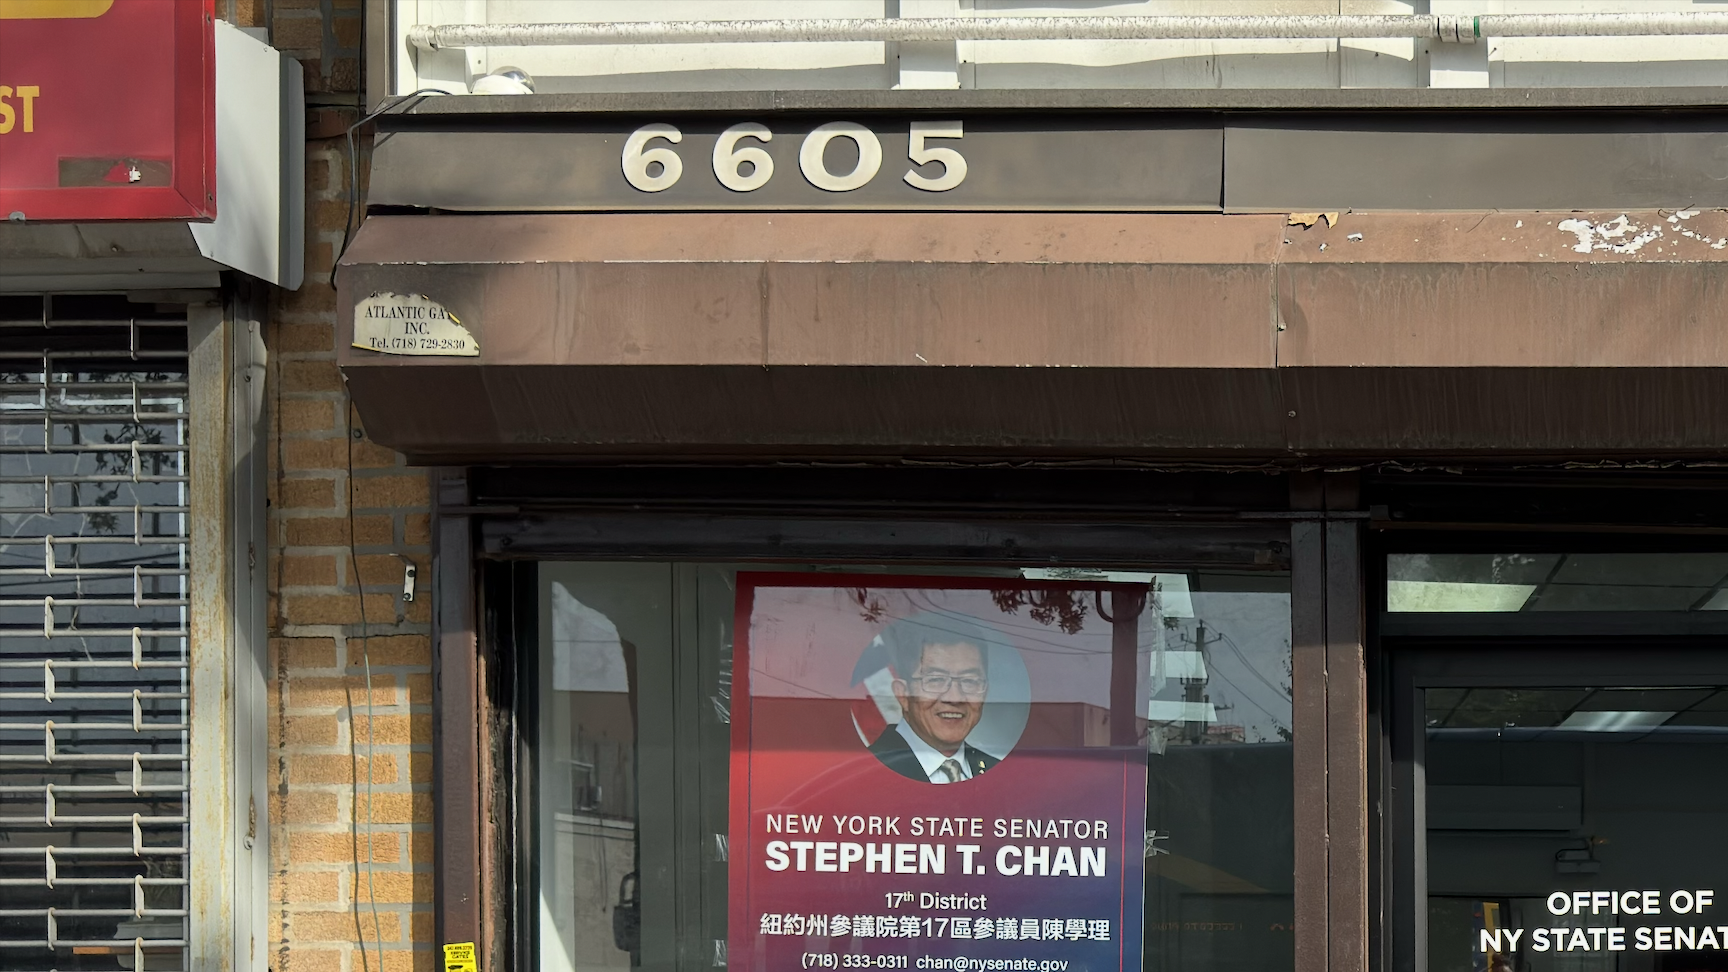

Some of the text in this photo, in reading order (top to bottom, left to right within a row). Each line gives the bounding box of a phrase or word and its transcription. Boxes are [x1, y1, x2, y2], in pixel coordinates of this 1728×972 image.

[621, 121, 968, 193] 6605
[365, 305, 425, 320] ATLANTIC
[404, 322, 430, 335] INC.
[370, 337, 465, 350] Tel. (718) 729-2830
[765, 813, 1109, 840] NEW YORK STATE SENATOR
[765, 841, 1107, 877] STEPHEN T. CHAN
[885, 891, 988, 911] 17th District
[1547, 890, 1715, 915] OFFICE OF
[759, 913, 1111, 941] 紐約州參議院第17區參議員陳學理
[1480, 928, 1524, 953] NY
[1532, 927, 1626, 952] STATE
[801, 952, 839, 970] (718)
[842, 952, 908, 969] 333-0311
